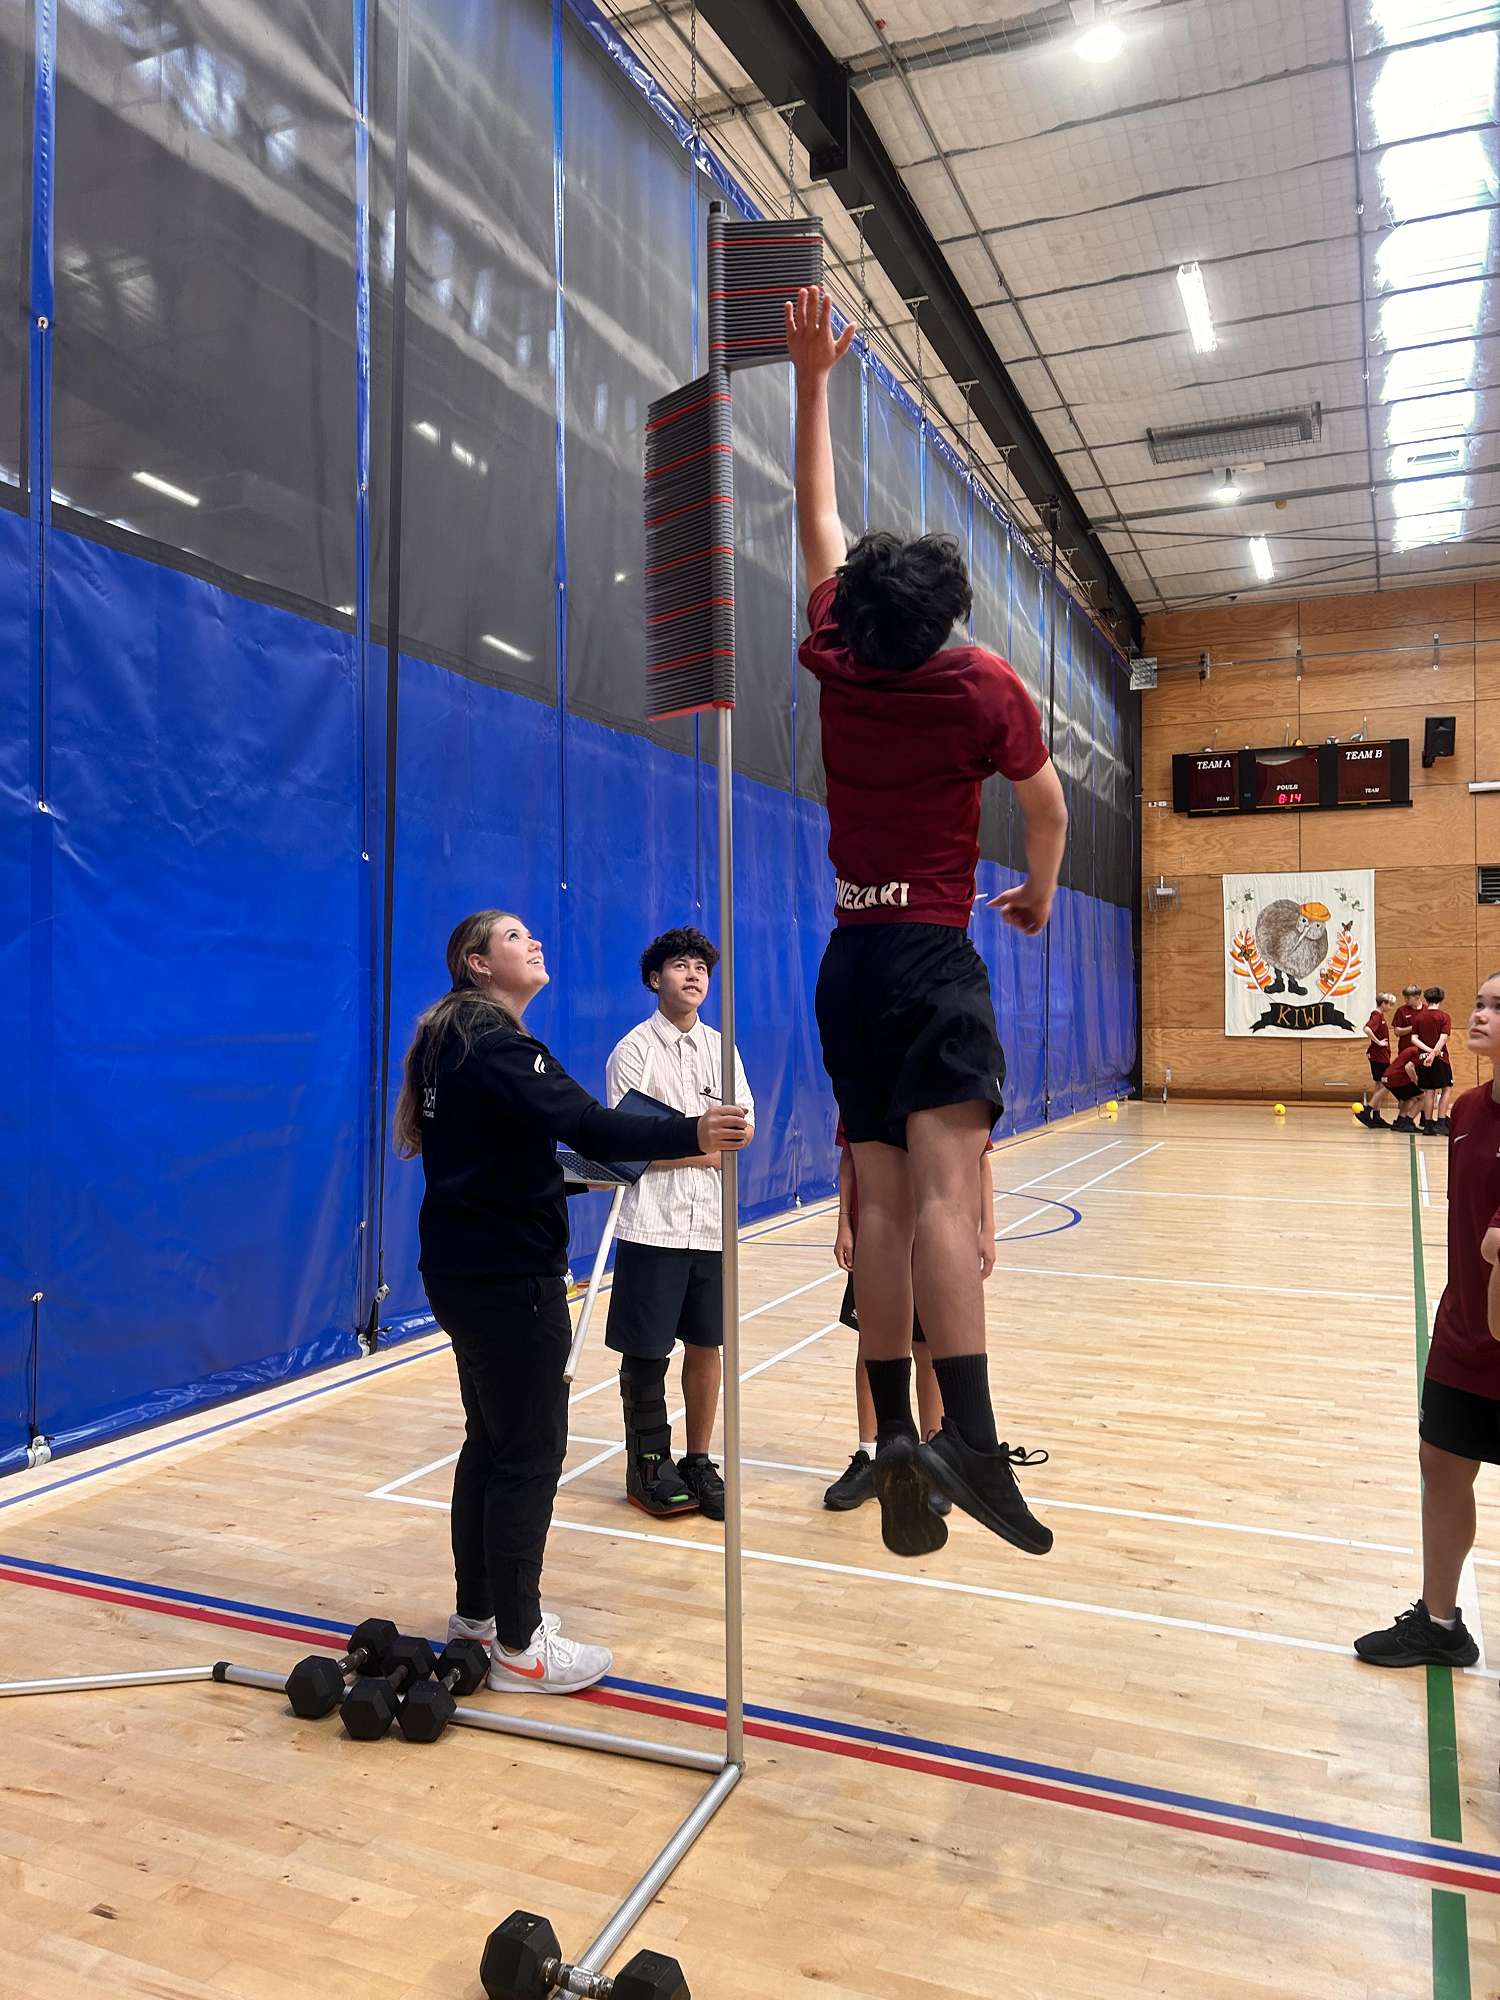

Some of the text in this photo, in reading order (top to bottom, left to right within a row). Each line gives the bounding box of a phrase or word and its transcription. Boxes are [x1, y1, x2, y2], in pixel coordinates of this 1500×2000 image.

[1345, 749, 1383, 760] TEAM B
[1196, 759, 1232, 770] TEAM A
[1277, 1004, 1324, 1027] KIWI
